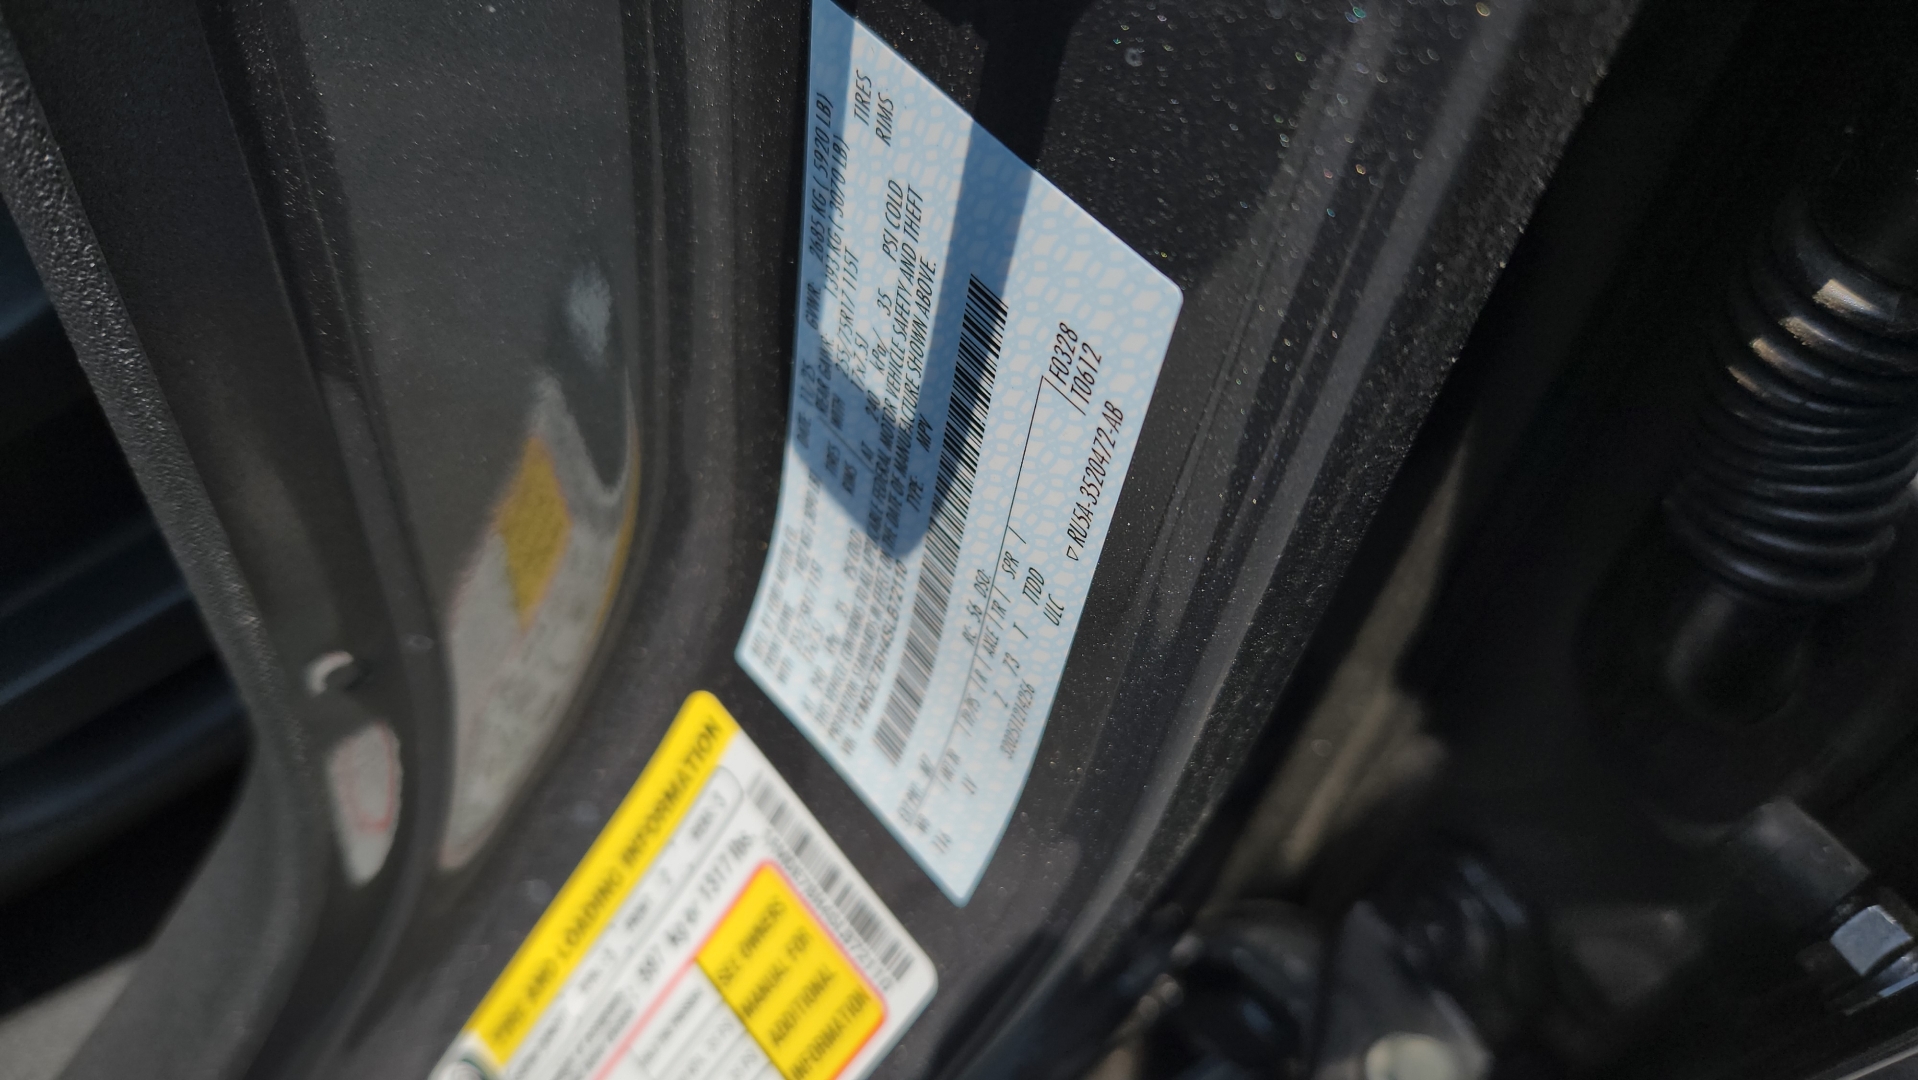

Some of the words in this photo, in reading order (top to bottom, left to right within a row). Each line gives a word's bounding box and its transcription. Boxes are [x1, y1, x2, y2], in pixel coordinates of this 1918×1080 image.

[816, 89, 833, 129] LB)
[853, 67, 872, 127] TIRES
[875, 89, 894, 147] RIMS
[813, 124, 830, 178] 5920
[832, 132, 850, 170] LB)
[811, 187, 827, 219] KG
[829, 166, 845, 219] 3070
[884, 177, 904, 231] COLD
[902, 183, 923, 244] THEFT
[808, 214, 824, 263] 2685
[827, 226, 841, 257] KG
[882, 227, 898, 262] PSI
[898, 239, 916, 285] AND
[824, 253, 839, 298] 1393
[842, 245, 859, 290] 115T
[914, 251, 936, 319] ABOVE.
[877, 287, 892, 317] 35
[892, 279, 913, 342] SAFETY
[835, 289, 855, 379] 255/75R17
[869, 327, 890, 375] kPa/
[906, 313, 928, 379] SHOWN
[1049, 320, 1078, 385] F0328
[850, 331, 869, 393] 17x7.5J
[885, 335, 905, 401] VEHICLE
[1070, 340, 1100, 406] T0612
[865, 388, 880, 423] 240
[878, 395, 897, 452] MOTOR
[892, 372, 920, 478] MANUFACTURE
[871, 447, 890, 504] FEDERAL
[890, 469, 905, 496] OF
[906, 471, 924, 513] TYPE:
[915, 412, 934, 453] MPV
[884, 488, 902, 528] DATE
[1043, 592, 1064, 628] ULC
[1067, 397, 1124, 549] RU5A-3520472-AB
[973, 565, 991, 599] DSO:
[966, 598, 983, 623] 56
[974, 668, 987, 684] R
[982, 625, 999, 658] AXLE
[991, 598, 1006, 621] TR
[1001, 549, 1019, 580] SPR
[1002, 650, 1020, 678] 73
[1012, 621, 1028, 641] T
[1021, 564, 1046, 608] TTDD
[619, 716, 723, 868] INFORMATION
